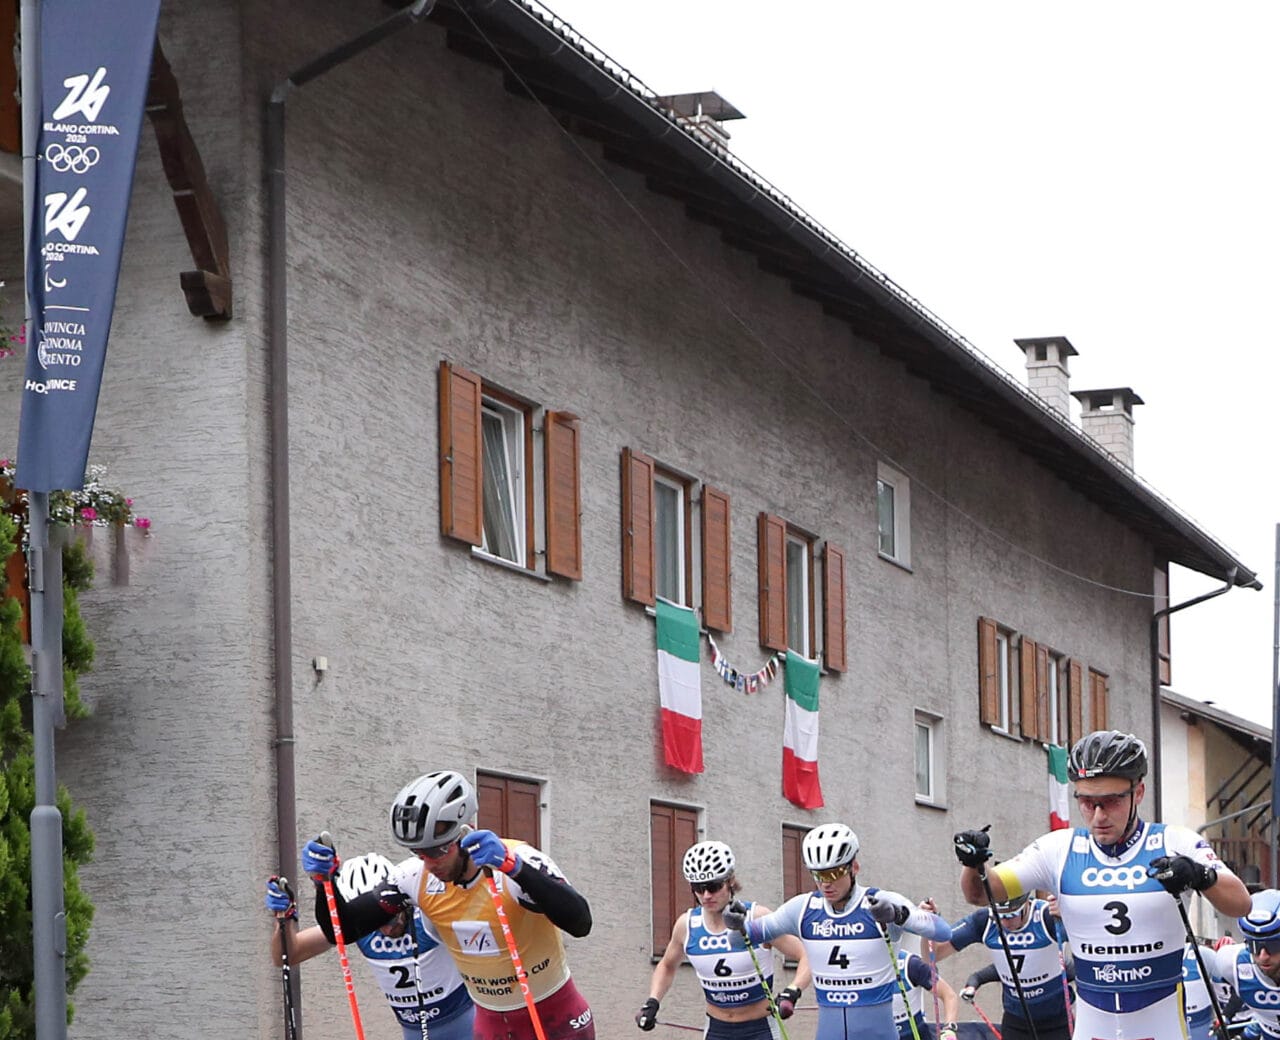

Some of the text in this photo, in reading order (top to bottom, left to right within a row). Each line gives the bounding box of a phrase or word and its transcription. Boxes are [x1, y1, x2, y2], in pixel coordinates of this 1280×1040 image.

[65, 133, 87, 143] 2026
[78, 125, 119, 136] CORTINA
[55, 243, 99, 255] CORTINA
[1081, 865, 1149, 890] coop
[1103, 900, 1132, 936] 3
[1081, 940, 1164, 955] fiemme
[828, 945, 850, 970] 4
[472, 975, 488, 985] SKI
[531, 958, 550, 975] CUP
[714, 958, 732, 977] 6
[389, 965, 415, 988] 2
[476, 986, 513, 996] SENIOR
[826, 991, 859, 1005] coop
